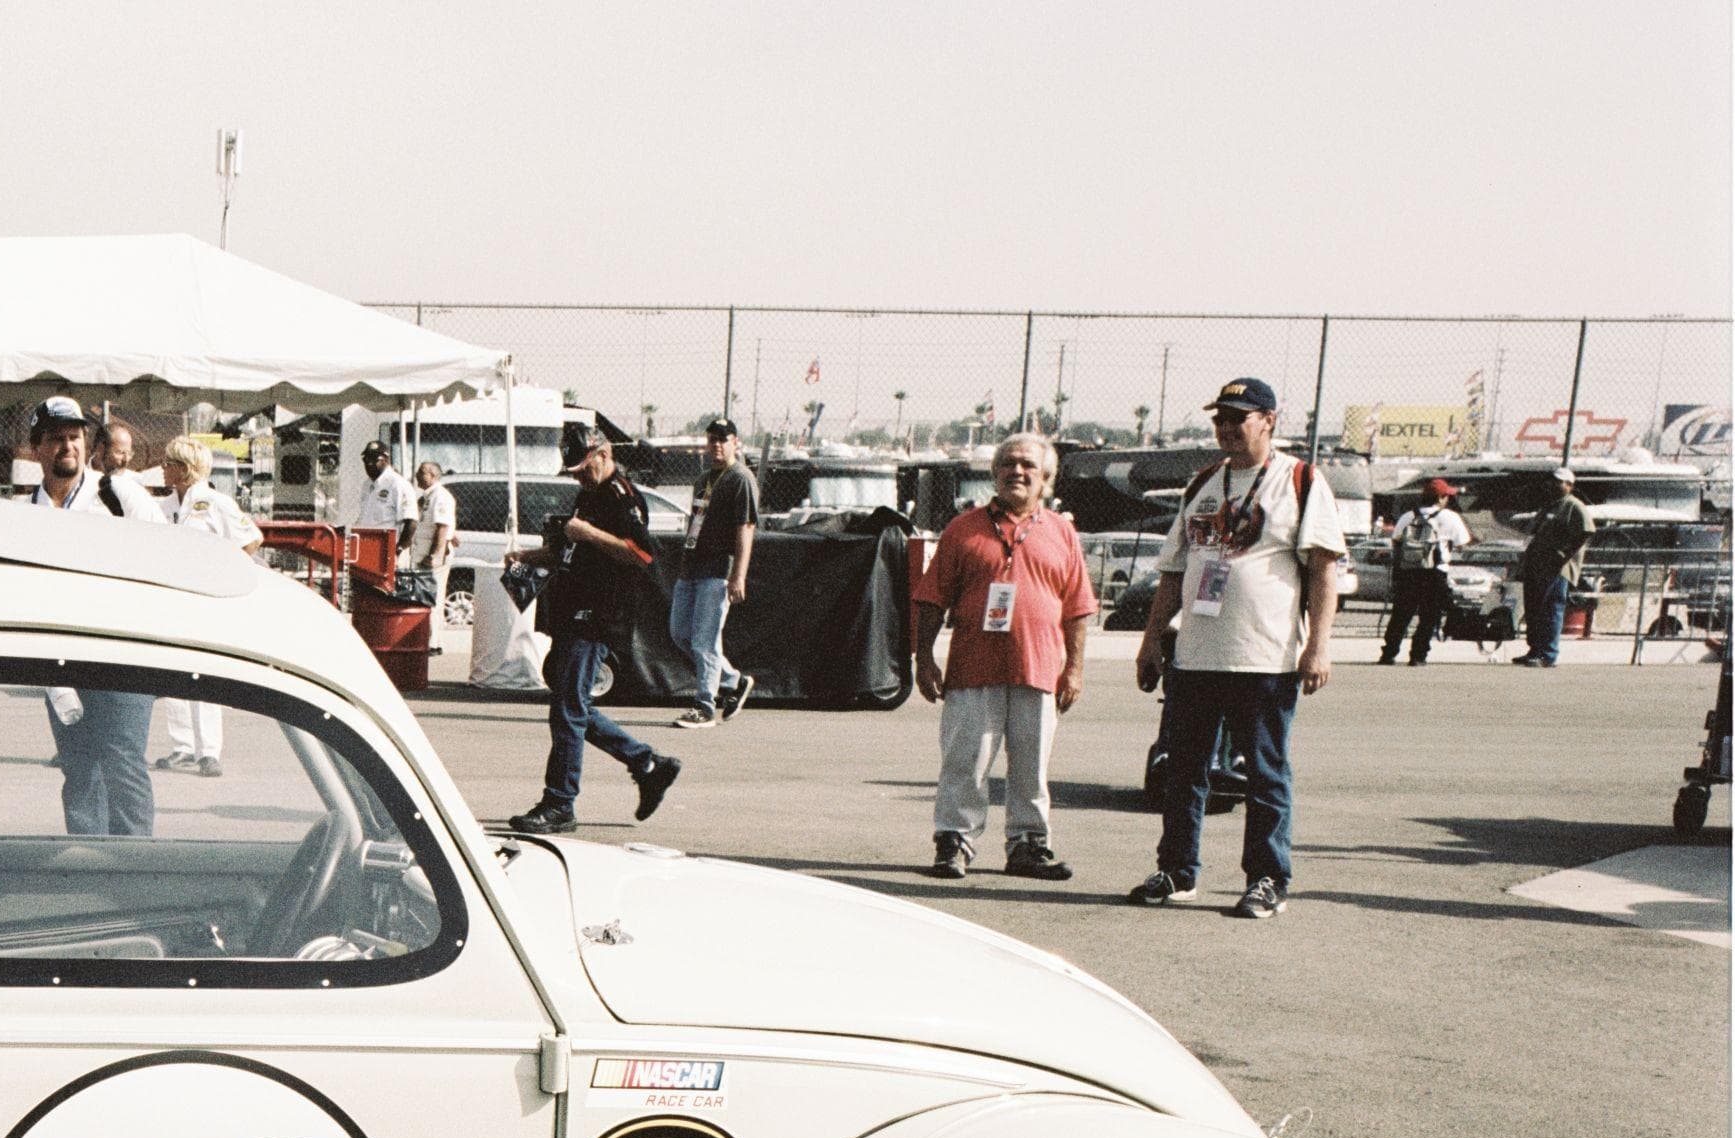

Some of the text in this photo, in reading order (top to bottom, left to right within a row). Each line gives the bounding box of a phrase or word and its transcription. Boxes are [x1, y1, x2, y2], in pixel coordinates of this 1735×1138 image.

[632, 1062, 716, 1089] NASCAR
[645, 1094, 725, 1108] RACE CAR
